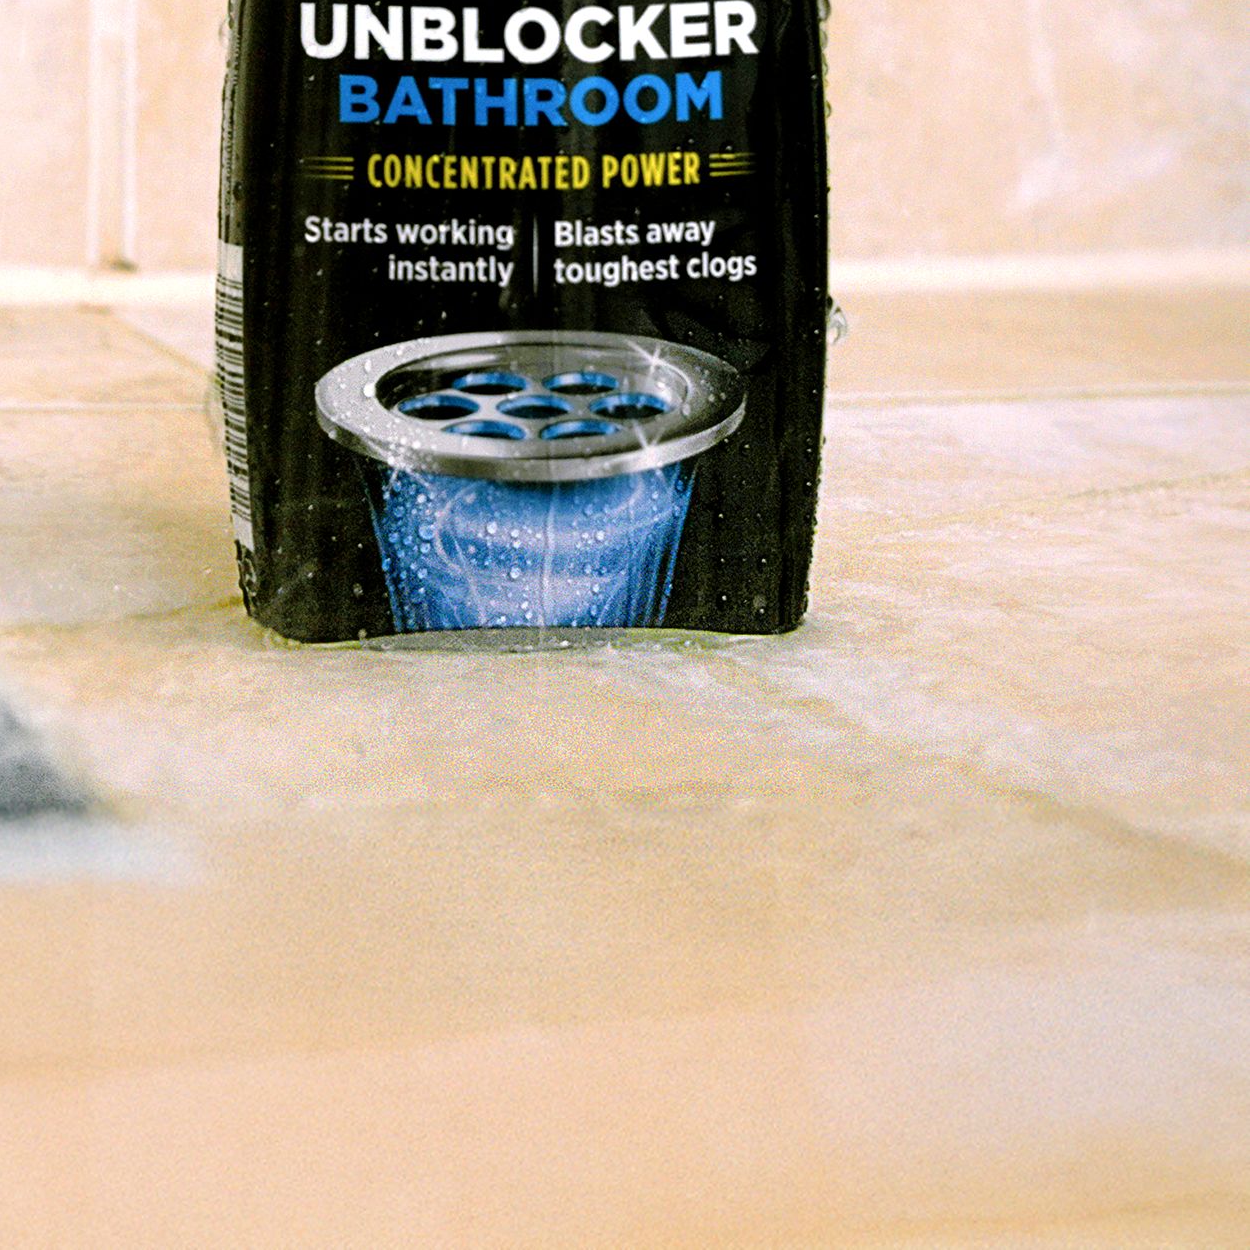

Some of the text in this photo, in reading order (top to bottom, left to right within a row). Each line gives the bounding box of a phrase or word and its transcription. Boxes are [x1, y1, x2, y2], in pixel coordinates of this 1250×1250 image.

[300, 0, 759, 64] UNBLOCKER
[338, 71, 724, 127] BATHROOM
[367, 152, 701, 190] CONCENTRATED POWER
[304, 216, 515, 251] Starts working
[554, 219, 716, 249] Blasts away
[388, 254, 515, 287] instantly
[554, 252, 757, 286] toughest clogs
